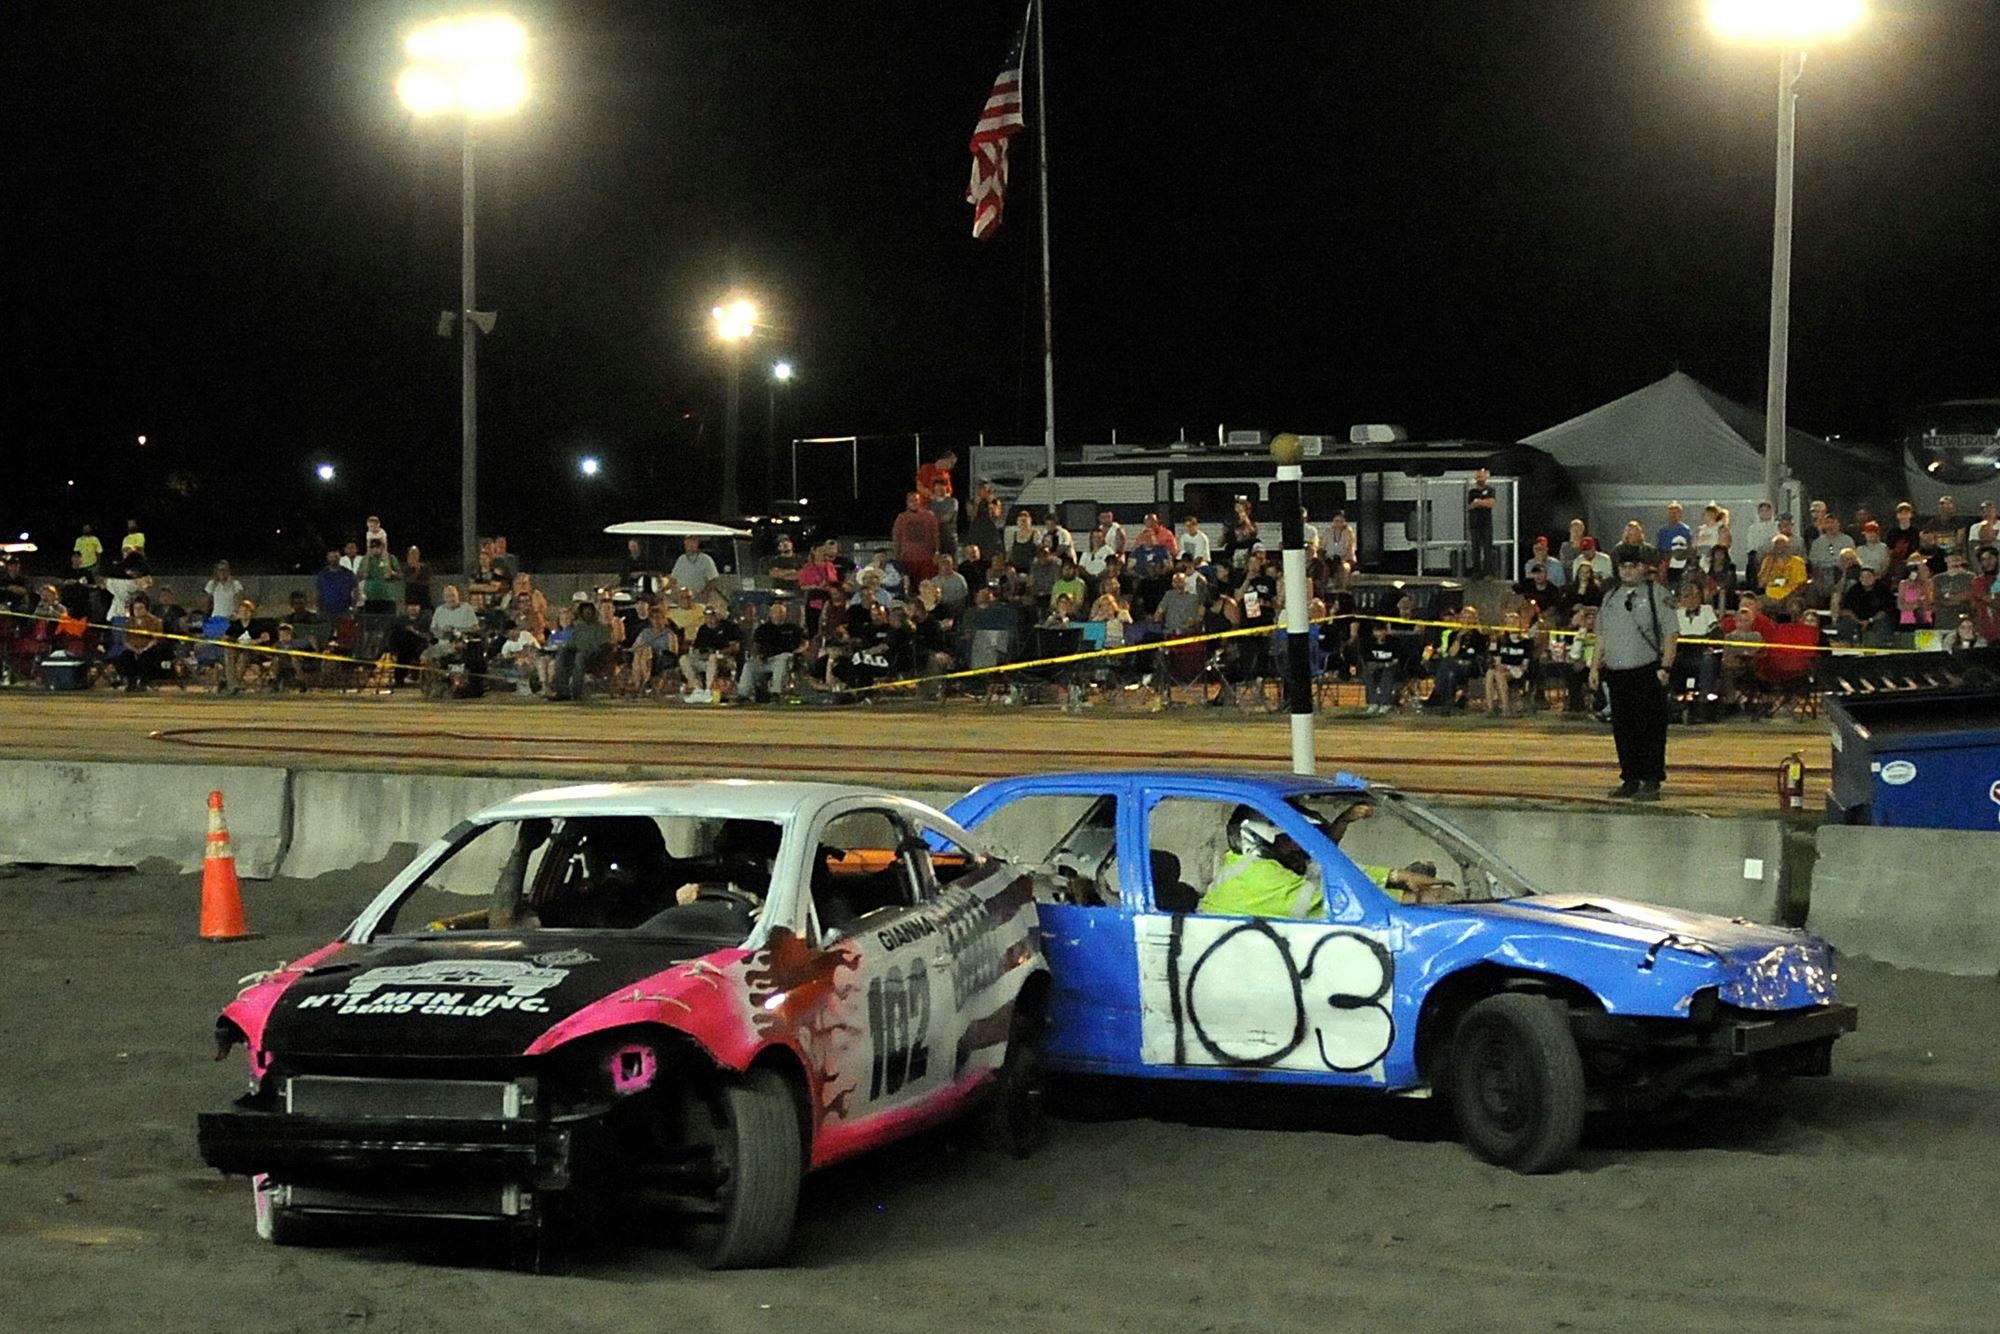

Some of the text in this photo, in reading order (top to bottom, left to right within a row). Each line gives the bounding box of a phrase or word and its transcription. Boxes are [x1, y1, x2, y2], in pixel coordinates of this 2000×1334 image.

[877, 916, 937, 952] GIANNA
[369, 992, 466, 1006] MEN
[473, 994, 550, 1013] INC.
[1166, 914, 1395, 1073] 103
[337, 1004, 494, 1017] DEMO CREW
